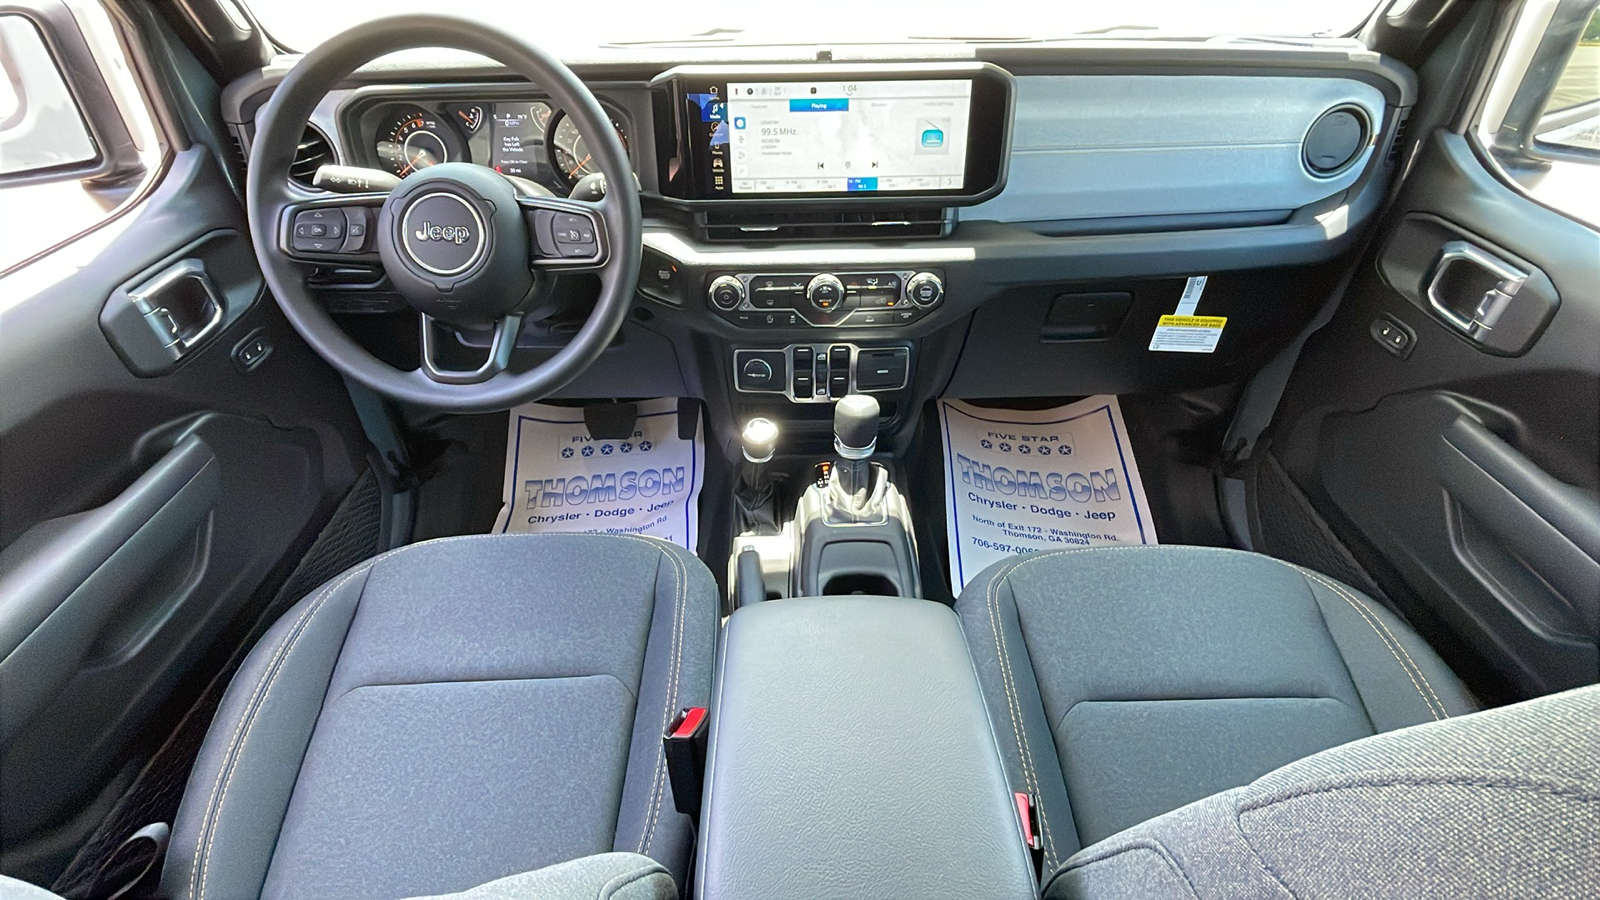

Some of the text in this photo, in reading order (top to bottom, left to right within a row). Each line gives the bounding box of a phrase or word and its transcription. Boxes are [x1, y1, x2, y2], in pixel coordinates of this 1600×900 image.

[761, 127, 797, 136] 99.5 MHz
[415, 221, 470, 246] Jeep
[571, 435, 594, 444] FIV
[987, 431, 1060, 443] FIVE STAR
[524, 466, 685, 511] THOMSON
[956, 452, 1122, 504] THOMSON
[527, 500, 675, 526] Chrysler Dodge Jeep
[967, 491, 1117, 522] Chrysler Dodge Jeep
[606, 521, 655, 535] Washington
[972, 514, 995, 527] North
[996, 521, 1006, 529] of
[1007, 522, 1025, 533] Exit
[1027, 526, 1042, 534] 172
[1049, 528, 1103, 542] Washington
[1103, 534, 1120, 542] Rd.
[1001, 529, 1090, 546] Thomson, GA 30824
